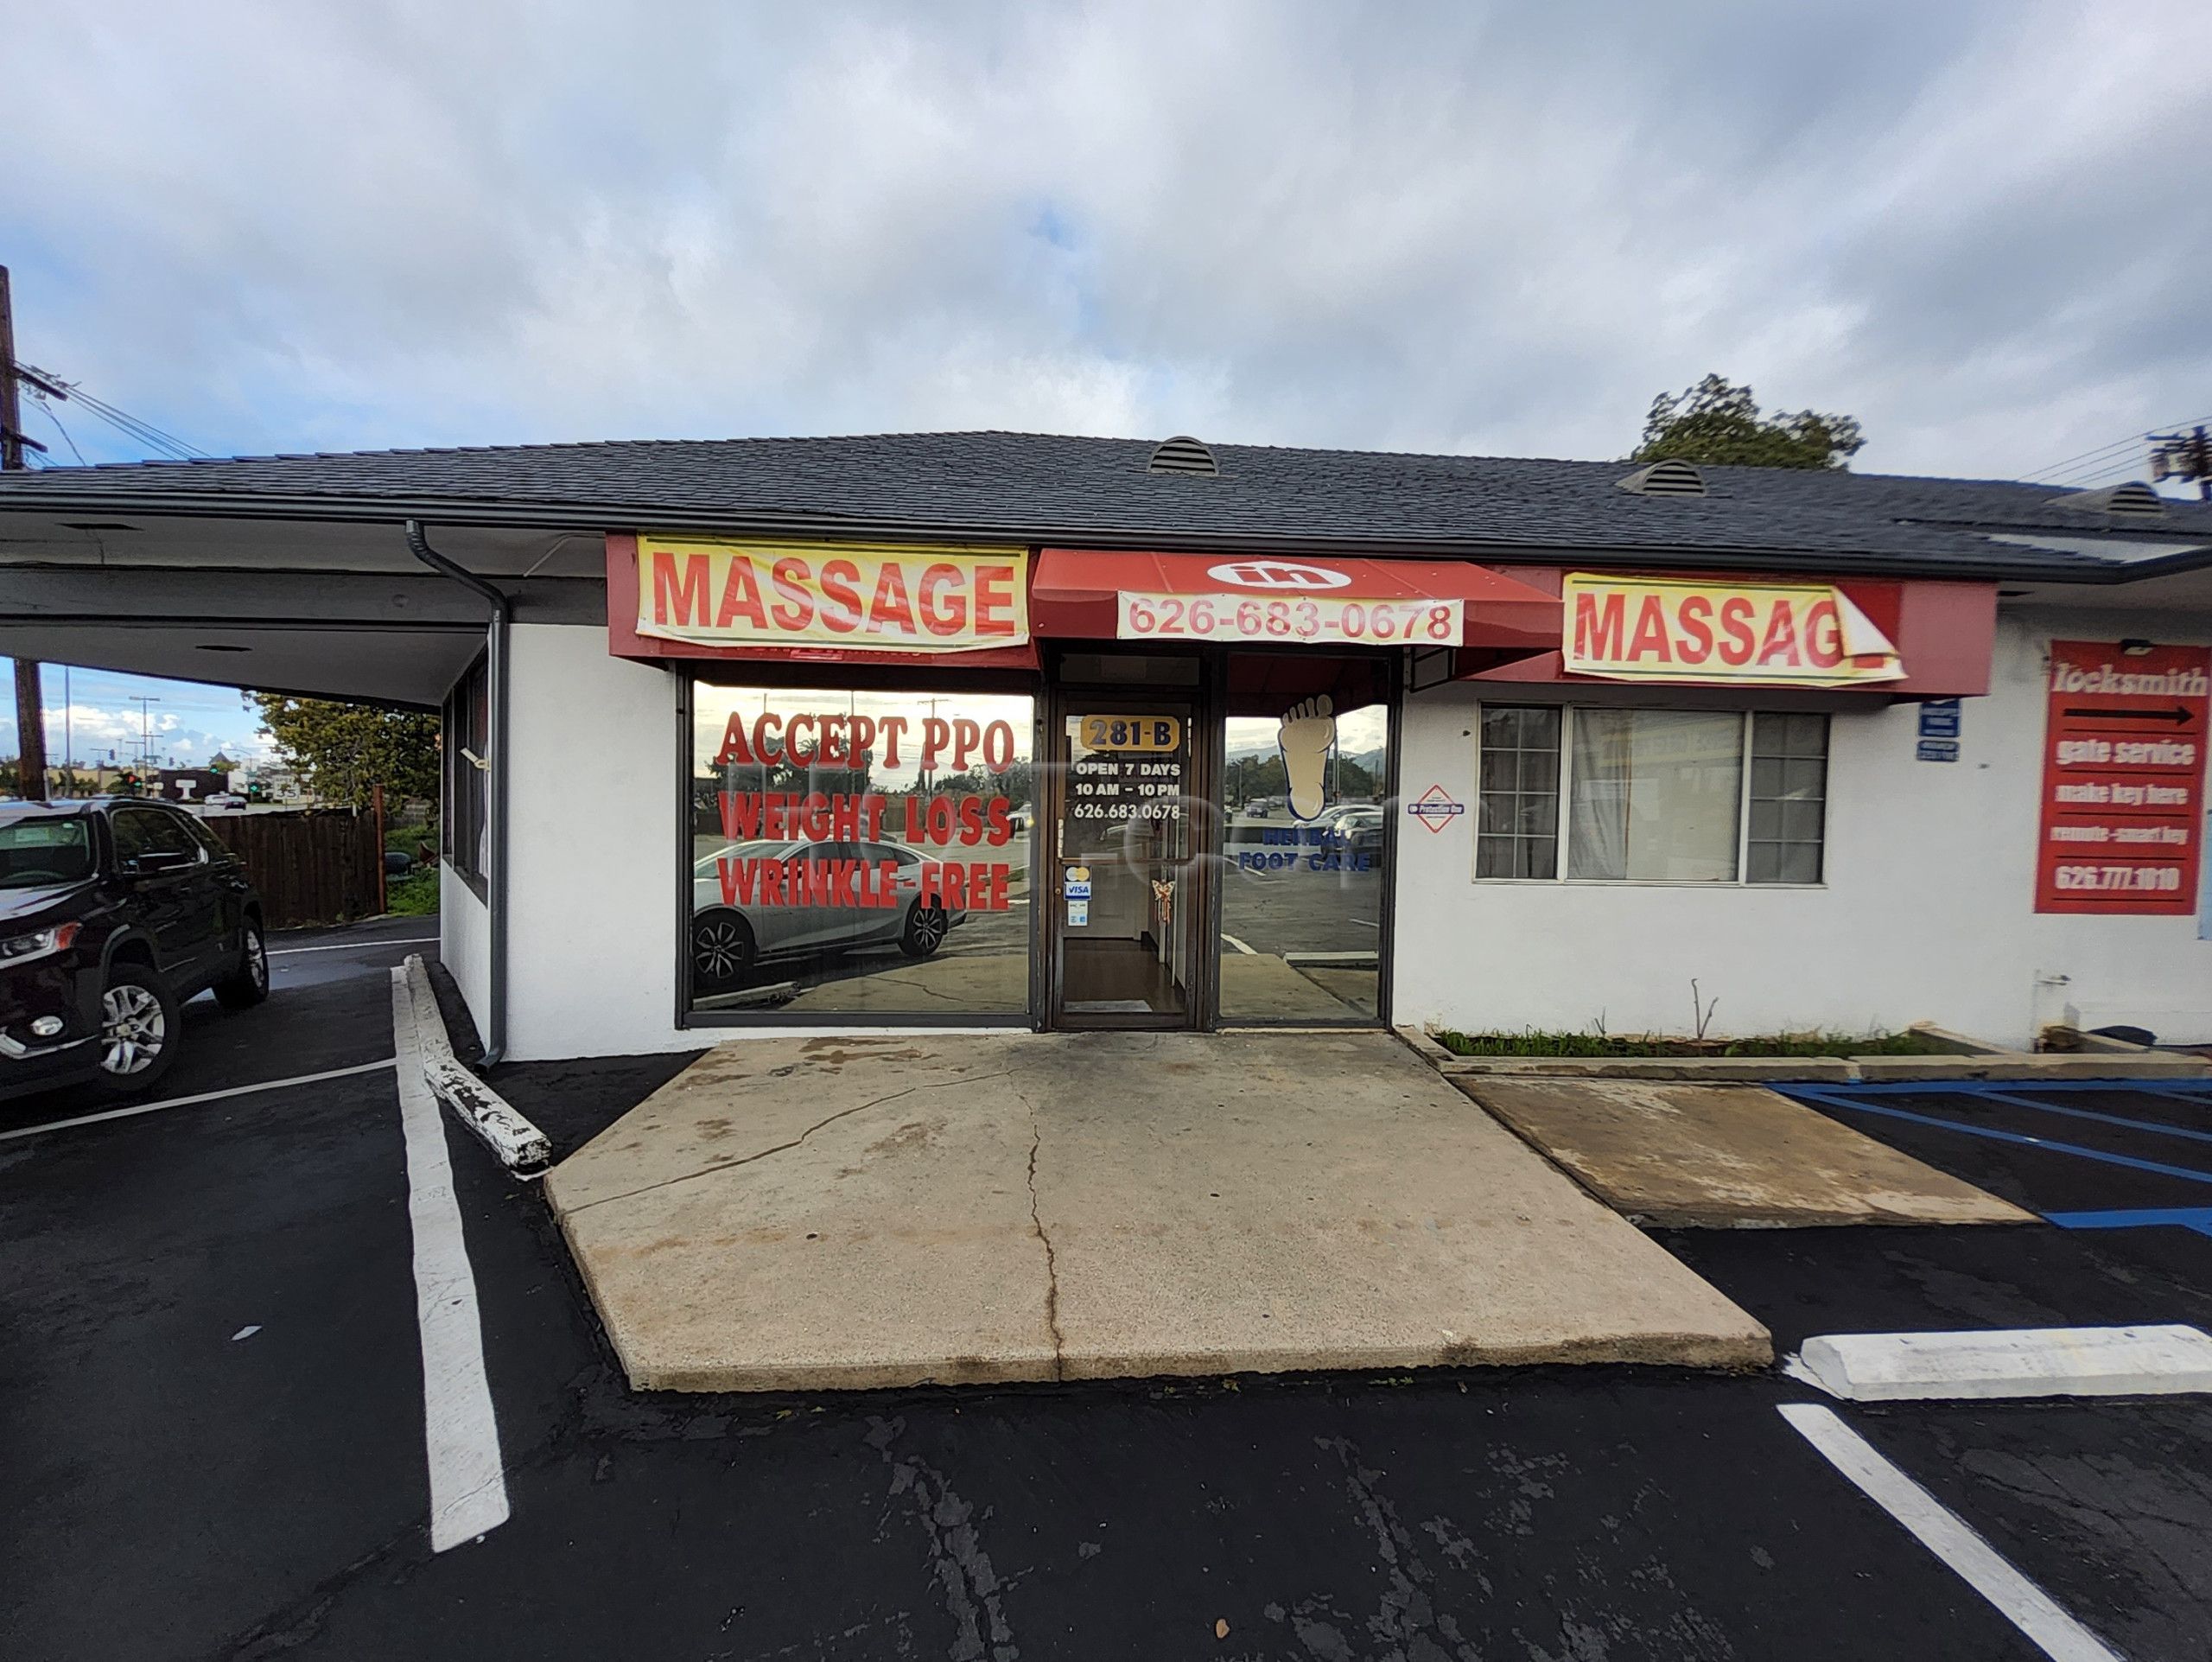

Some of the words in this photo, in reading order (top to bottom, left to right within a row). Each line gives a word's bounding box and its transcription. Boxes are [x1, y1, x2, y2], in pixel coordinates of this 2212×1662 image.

[653, 552, 1015, 637] MASSAGE
[1128, 597, 1452, 640] 626-683-0678
[1573, 592, 1885, 669] MASSAG
[2051, 662, 2209, 697] locksmith
[715, 711, 908, 770] ACCEPT
[922, 717, 1015, 774] PPO
[1089, 719, 1172, 746] 281-B
[1076, 762, 1119, 775] OPEN
[1125, 763, 1135, 775] 7
[1141, 763, 1181, 776] DAYS
[1076, 783, 1094, 795] 10
[1096, 783, 1120, 796] AM
[1138, 784, 1155, 796] 10
[1158, 784, 1180, 796] PM
[717, 791, 887, 843] WEIGHT
[905, 795, 1010, 847] LOSS
[1074, 803, 1180, 820] 626.683.0678
[1238, 851, 1299, 871] FOOT
[1308, 852, 1370, 872] CARE
[716, 856, 1010, 911] WRINKLE-FREE
[1069, 885, 1089, 894] VISA
